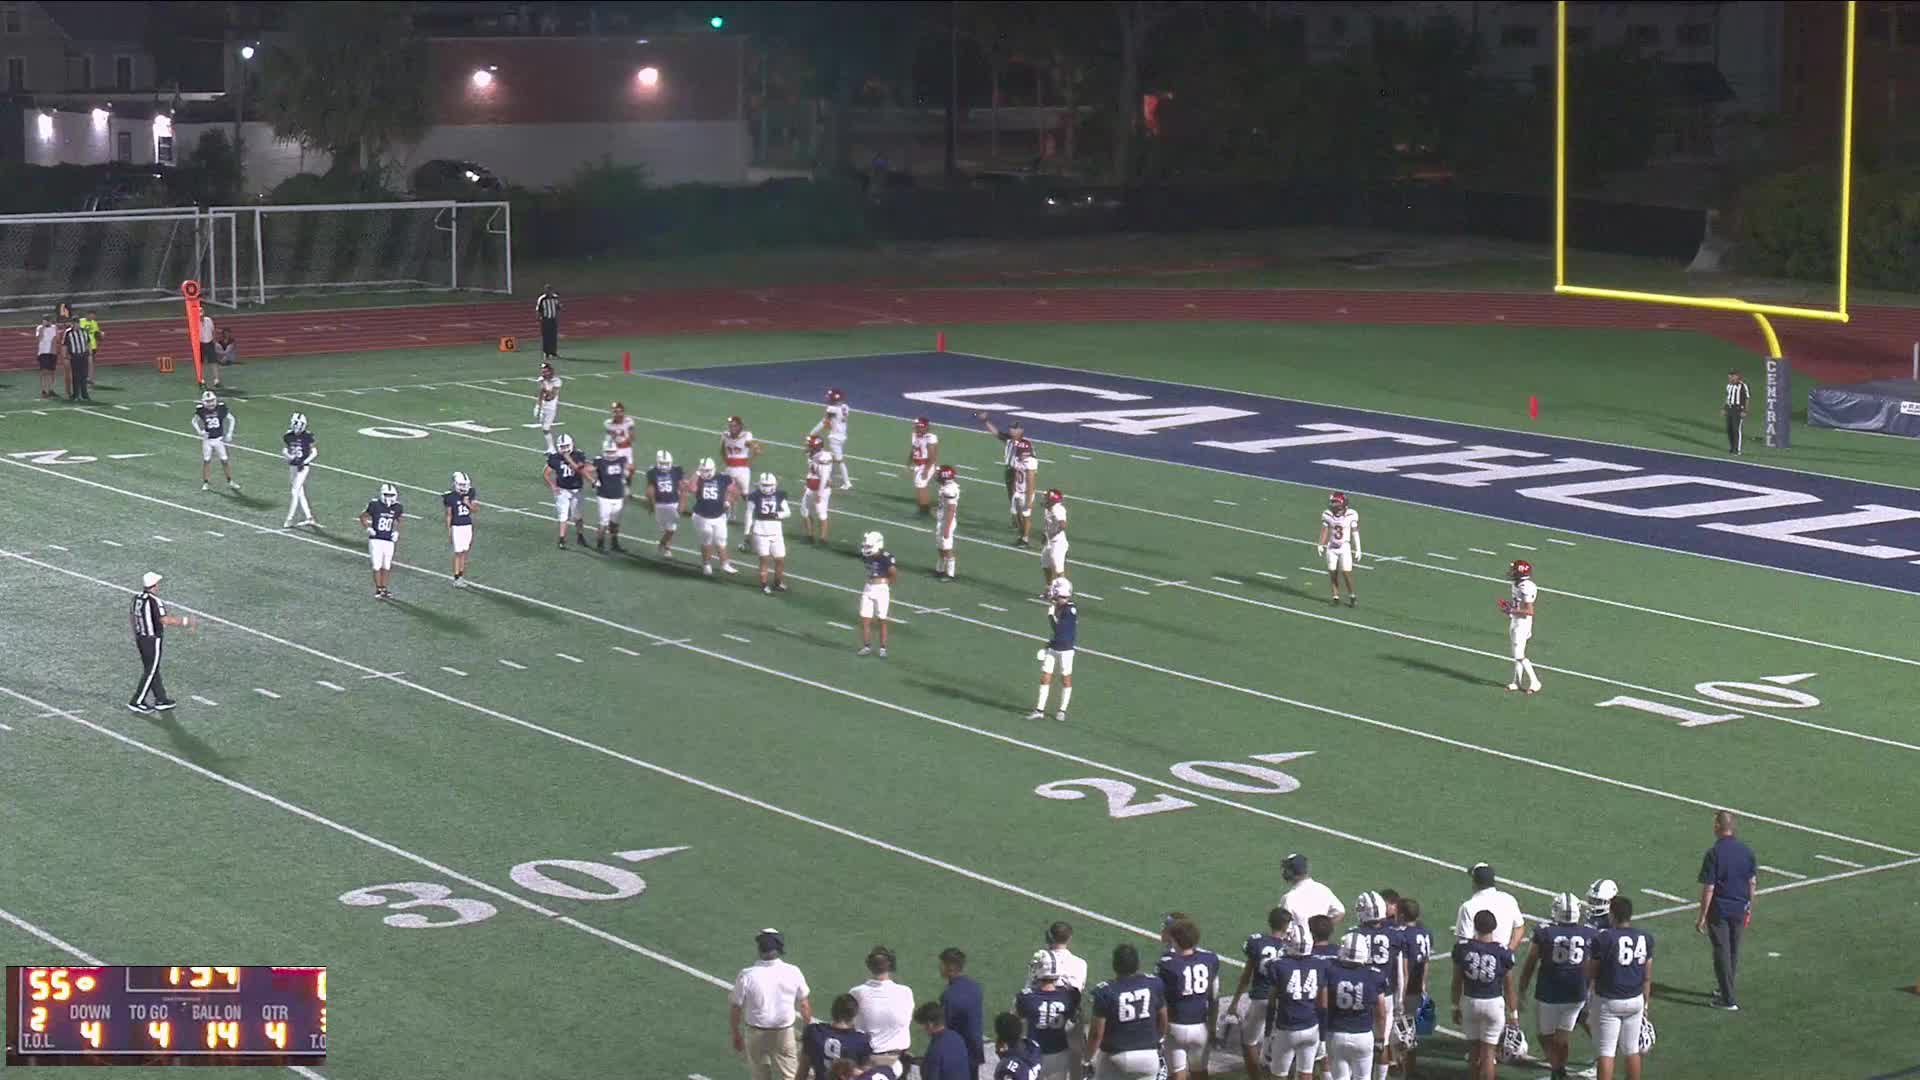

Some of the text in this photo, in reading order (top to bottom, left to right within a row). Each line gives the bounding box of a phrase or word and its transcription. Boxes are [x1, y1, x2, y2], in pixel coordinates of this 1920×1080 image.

[1765, 361, 1778, 447] CENTRAL
[900, 383, 1920, 565] CATHOL
[378, 517, 393, 531] 80
[1334, 525, 1343, 540] 3
[1552, 935, 1585, 965] 66
[1618, 935, 1648, 966] 64
[1182, 964, 1209, 996] 18
[1464, 951, 1497, 983] 38
[1286, 969, 1319, 1000] 44
[1335, 980, 1364, 1010] 61
[1036, 1001, 1065, 1030] 16
[1119, 988, 1151, 1023] 67
[1006, 1059, 1019, 1072] 12
